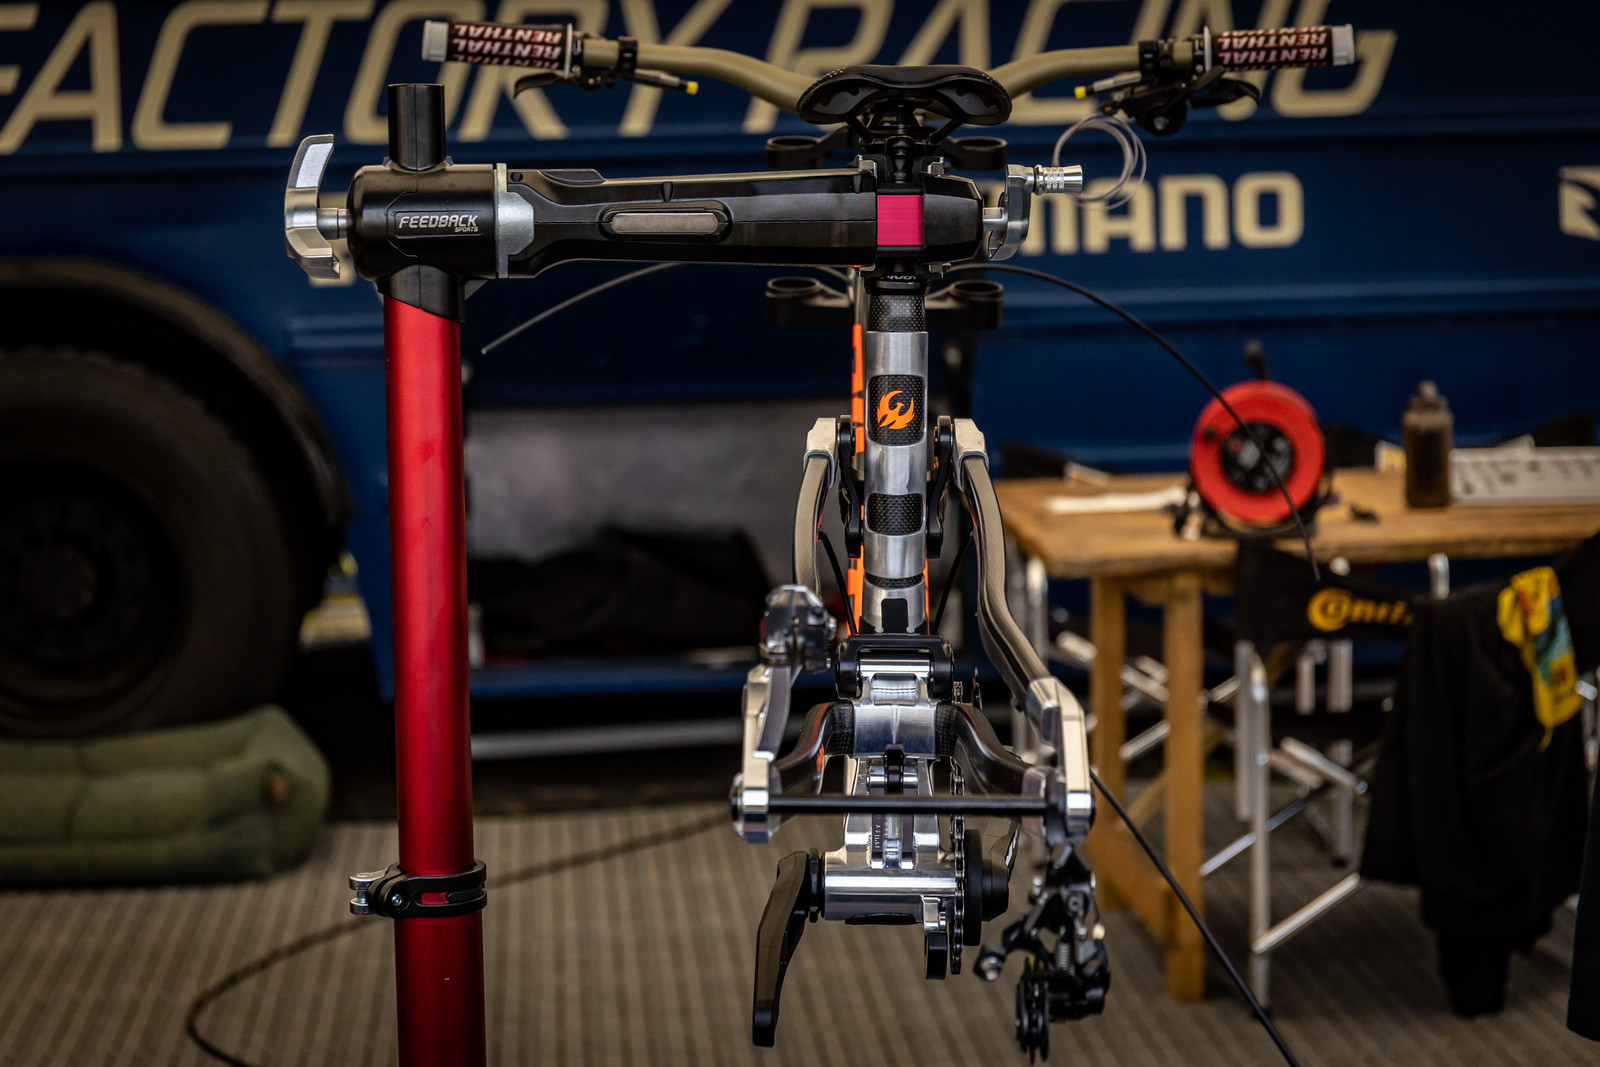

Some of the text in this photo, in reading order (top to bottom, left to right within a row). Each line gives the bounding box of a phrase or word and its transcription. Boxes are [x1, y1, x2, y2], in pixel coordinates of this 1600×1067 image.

[453, 24, 562, 44] RENTHAL
[1217, 32, 1328, 50] RENTHAL
[452, 39, 562, 60] RENTHAL
[1218, 47, 1328, 65] RENTHAL
[398, 214, 478, 229] FEEDBACK
